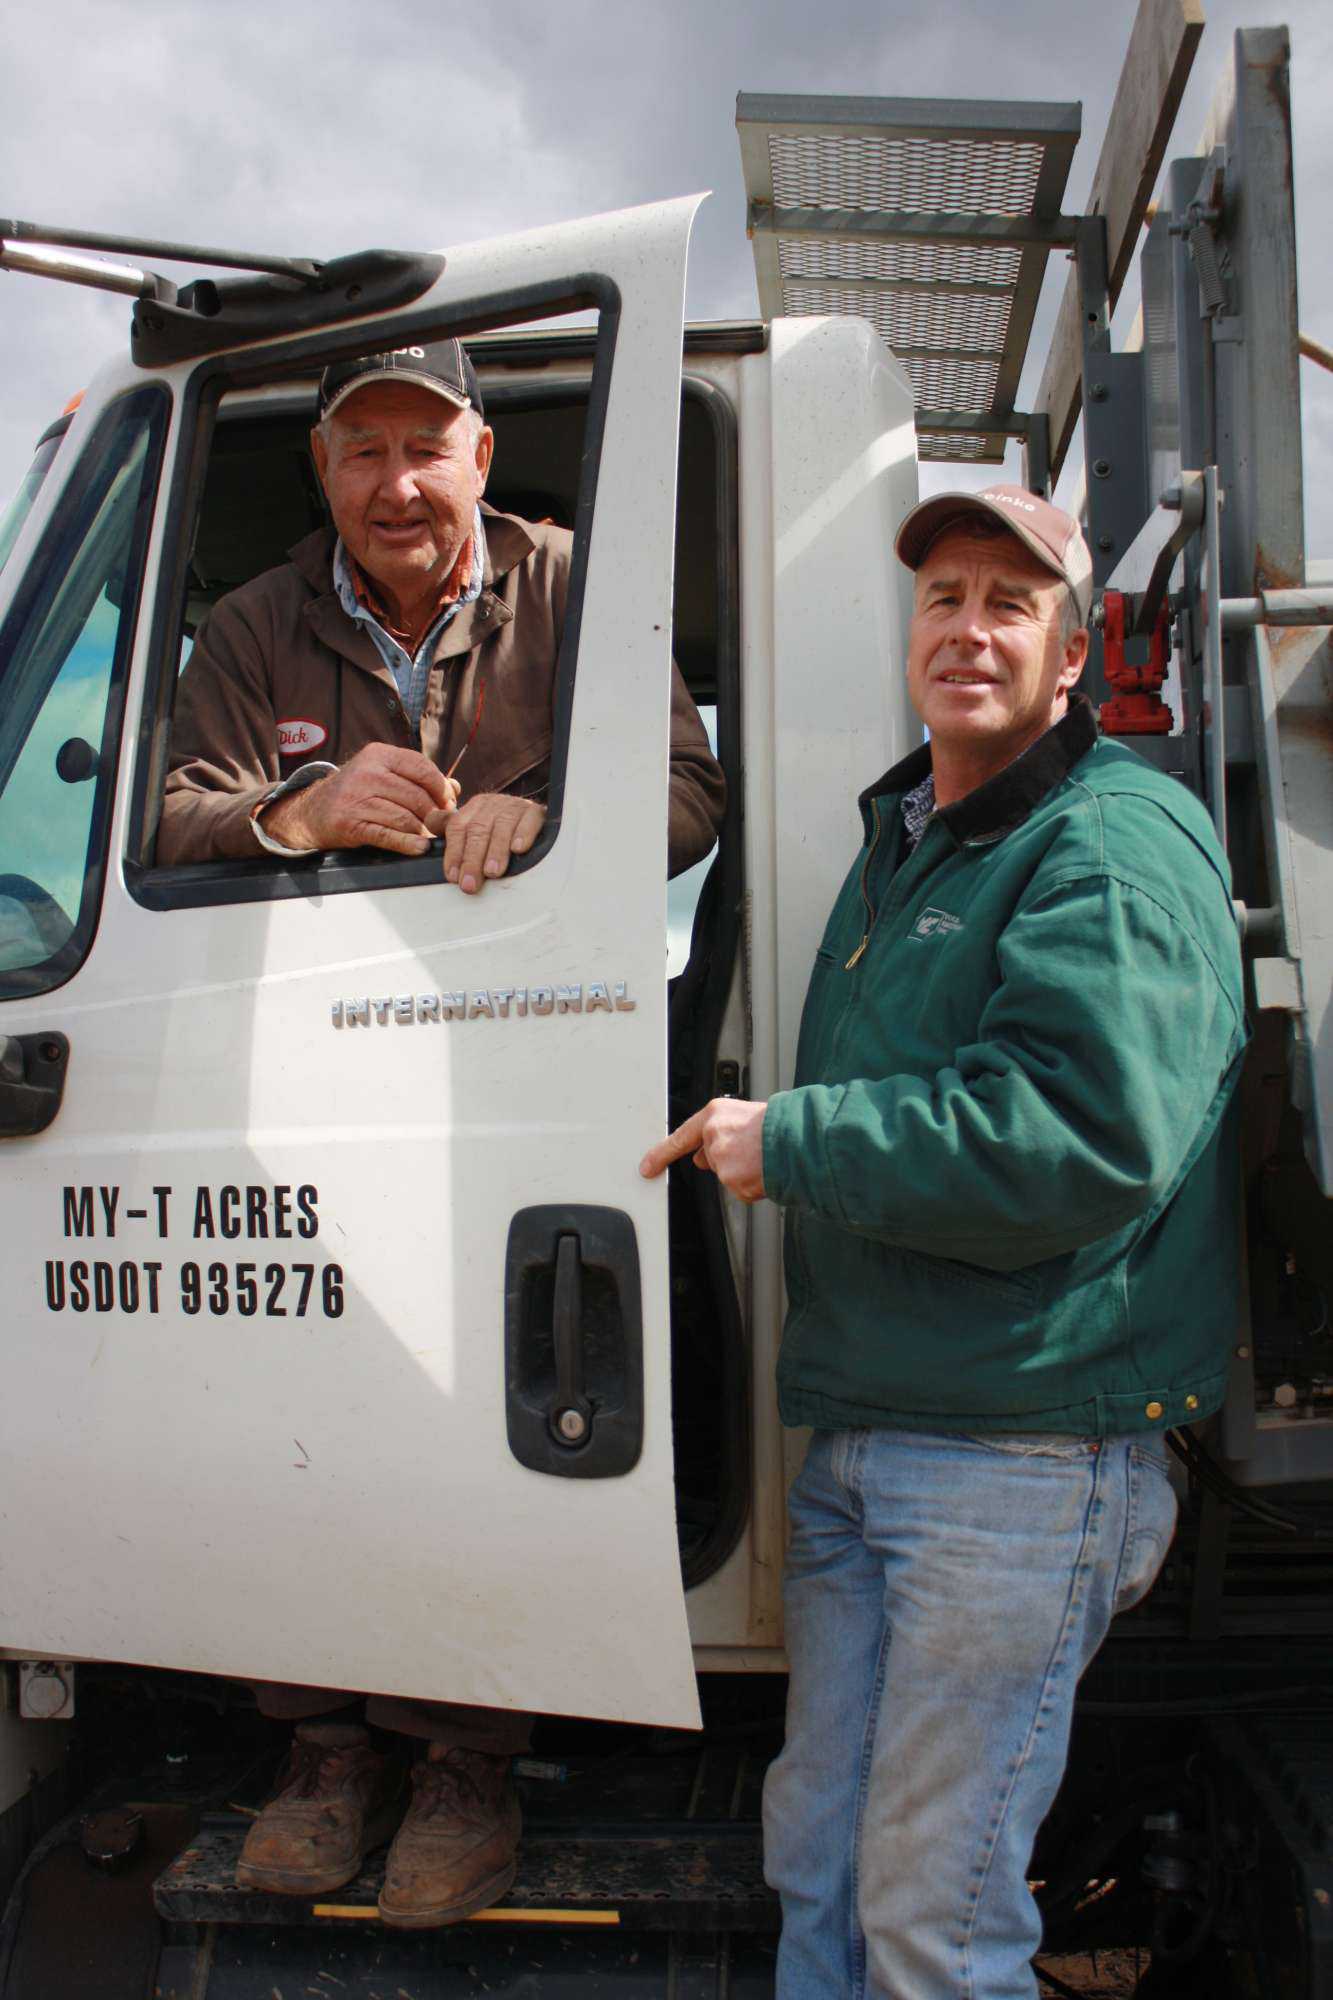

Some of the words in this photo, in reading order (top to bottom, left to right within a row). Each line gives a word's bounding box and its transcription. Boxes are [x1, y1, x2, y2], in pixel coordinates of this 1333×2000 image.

[279, 727, 309, 745] Dick
[331, 980, 637, 1030] INTERNATIONAL
[63, 1186, 172, 1238] MY-T
[193, 1184, 319, 1239] ACRES
[45, 1260, 162, 1314] USDOT
[180, 1262, 345, 1319] 935276
